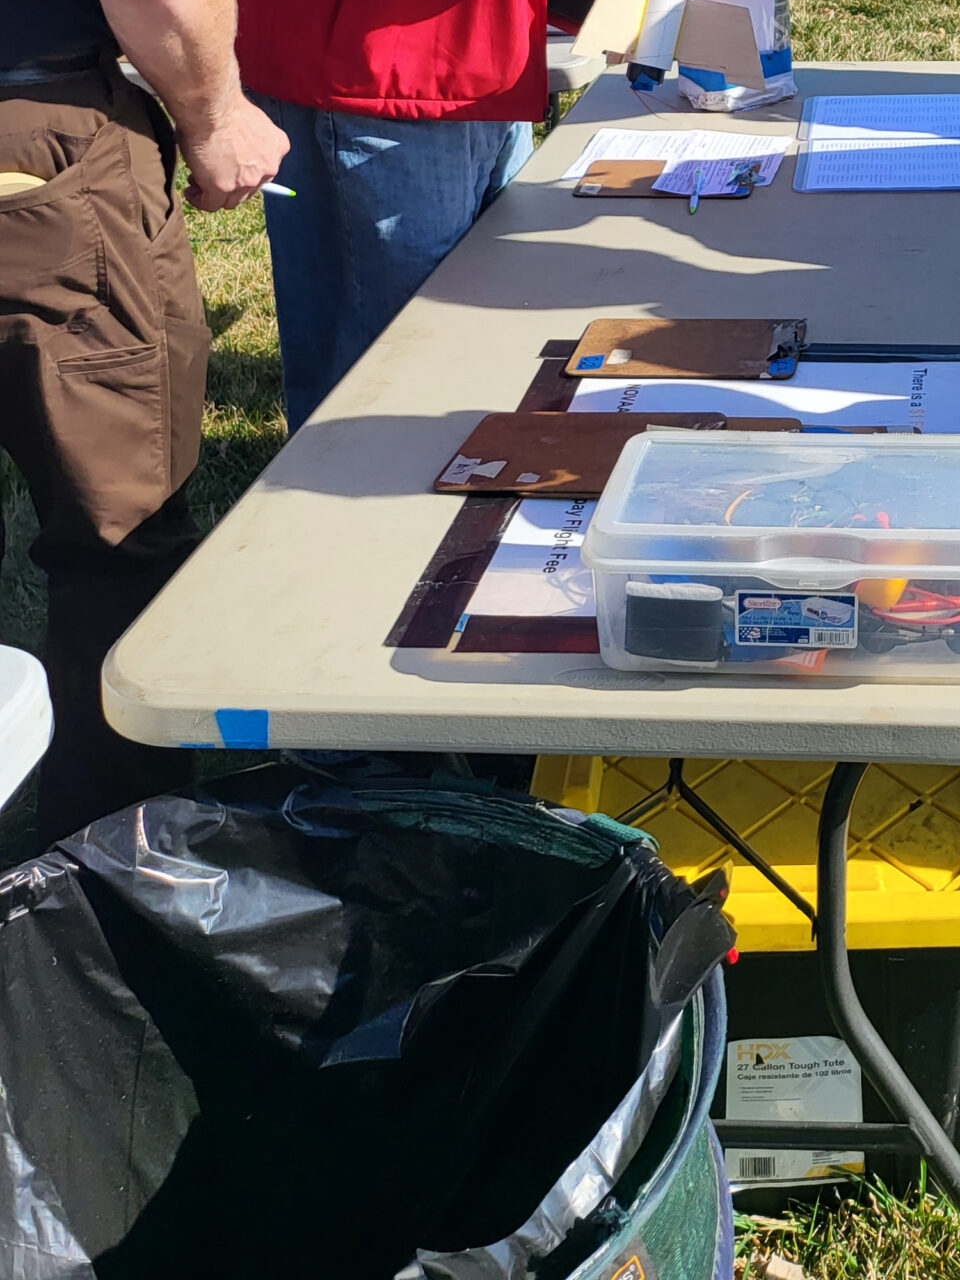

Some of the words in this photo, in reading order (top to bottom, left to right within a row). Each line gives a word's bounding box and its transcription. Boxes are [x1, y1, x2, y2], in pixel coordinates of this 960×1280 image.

[911, 368, 928, 391] There
[553, 520, 582, 551] Flight
[543, 553, 568, 574] Fee
[736, 1042, 791, 1061] HDX
[737, 1063, 749, 1071] 27
[788, 1061, 820, 1071] Tough
[823, 1059, 845, 1068] Tote
[737, 1073, 757, 1081] Caja
[801, 1071, 812, 1079] de
